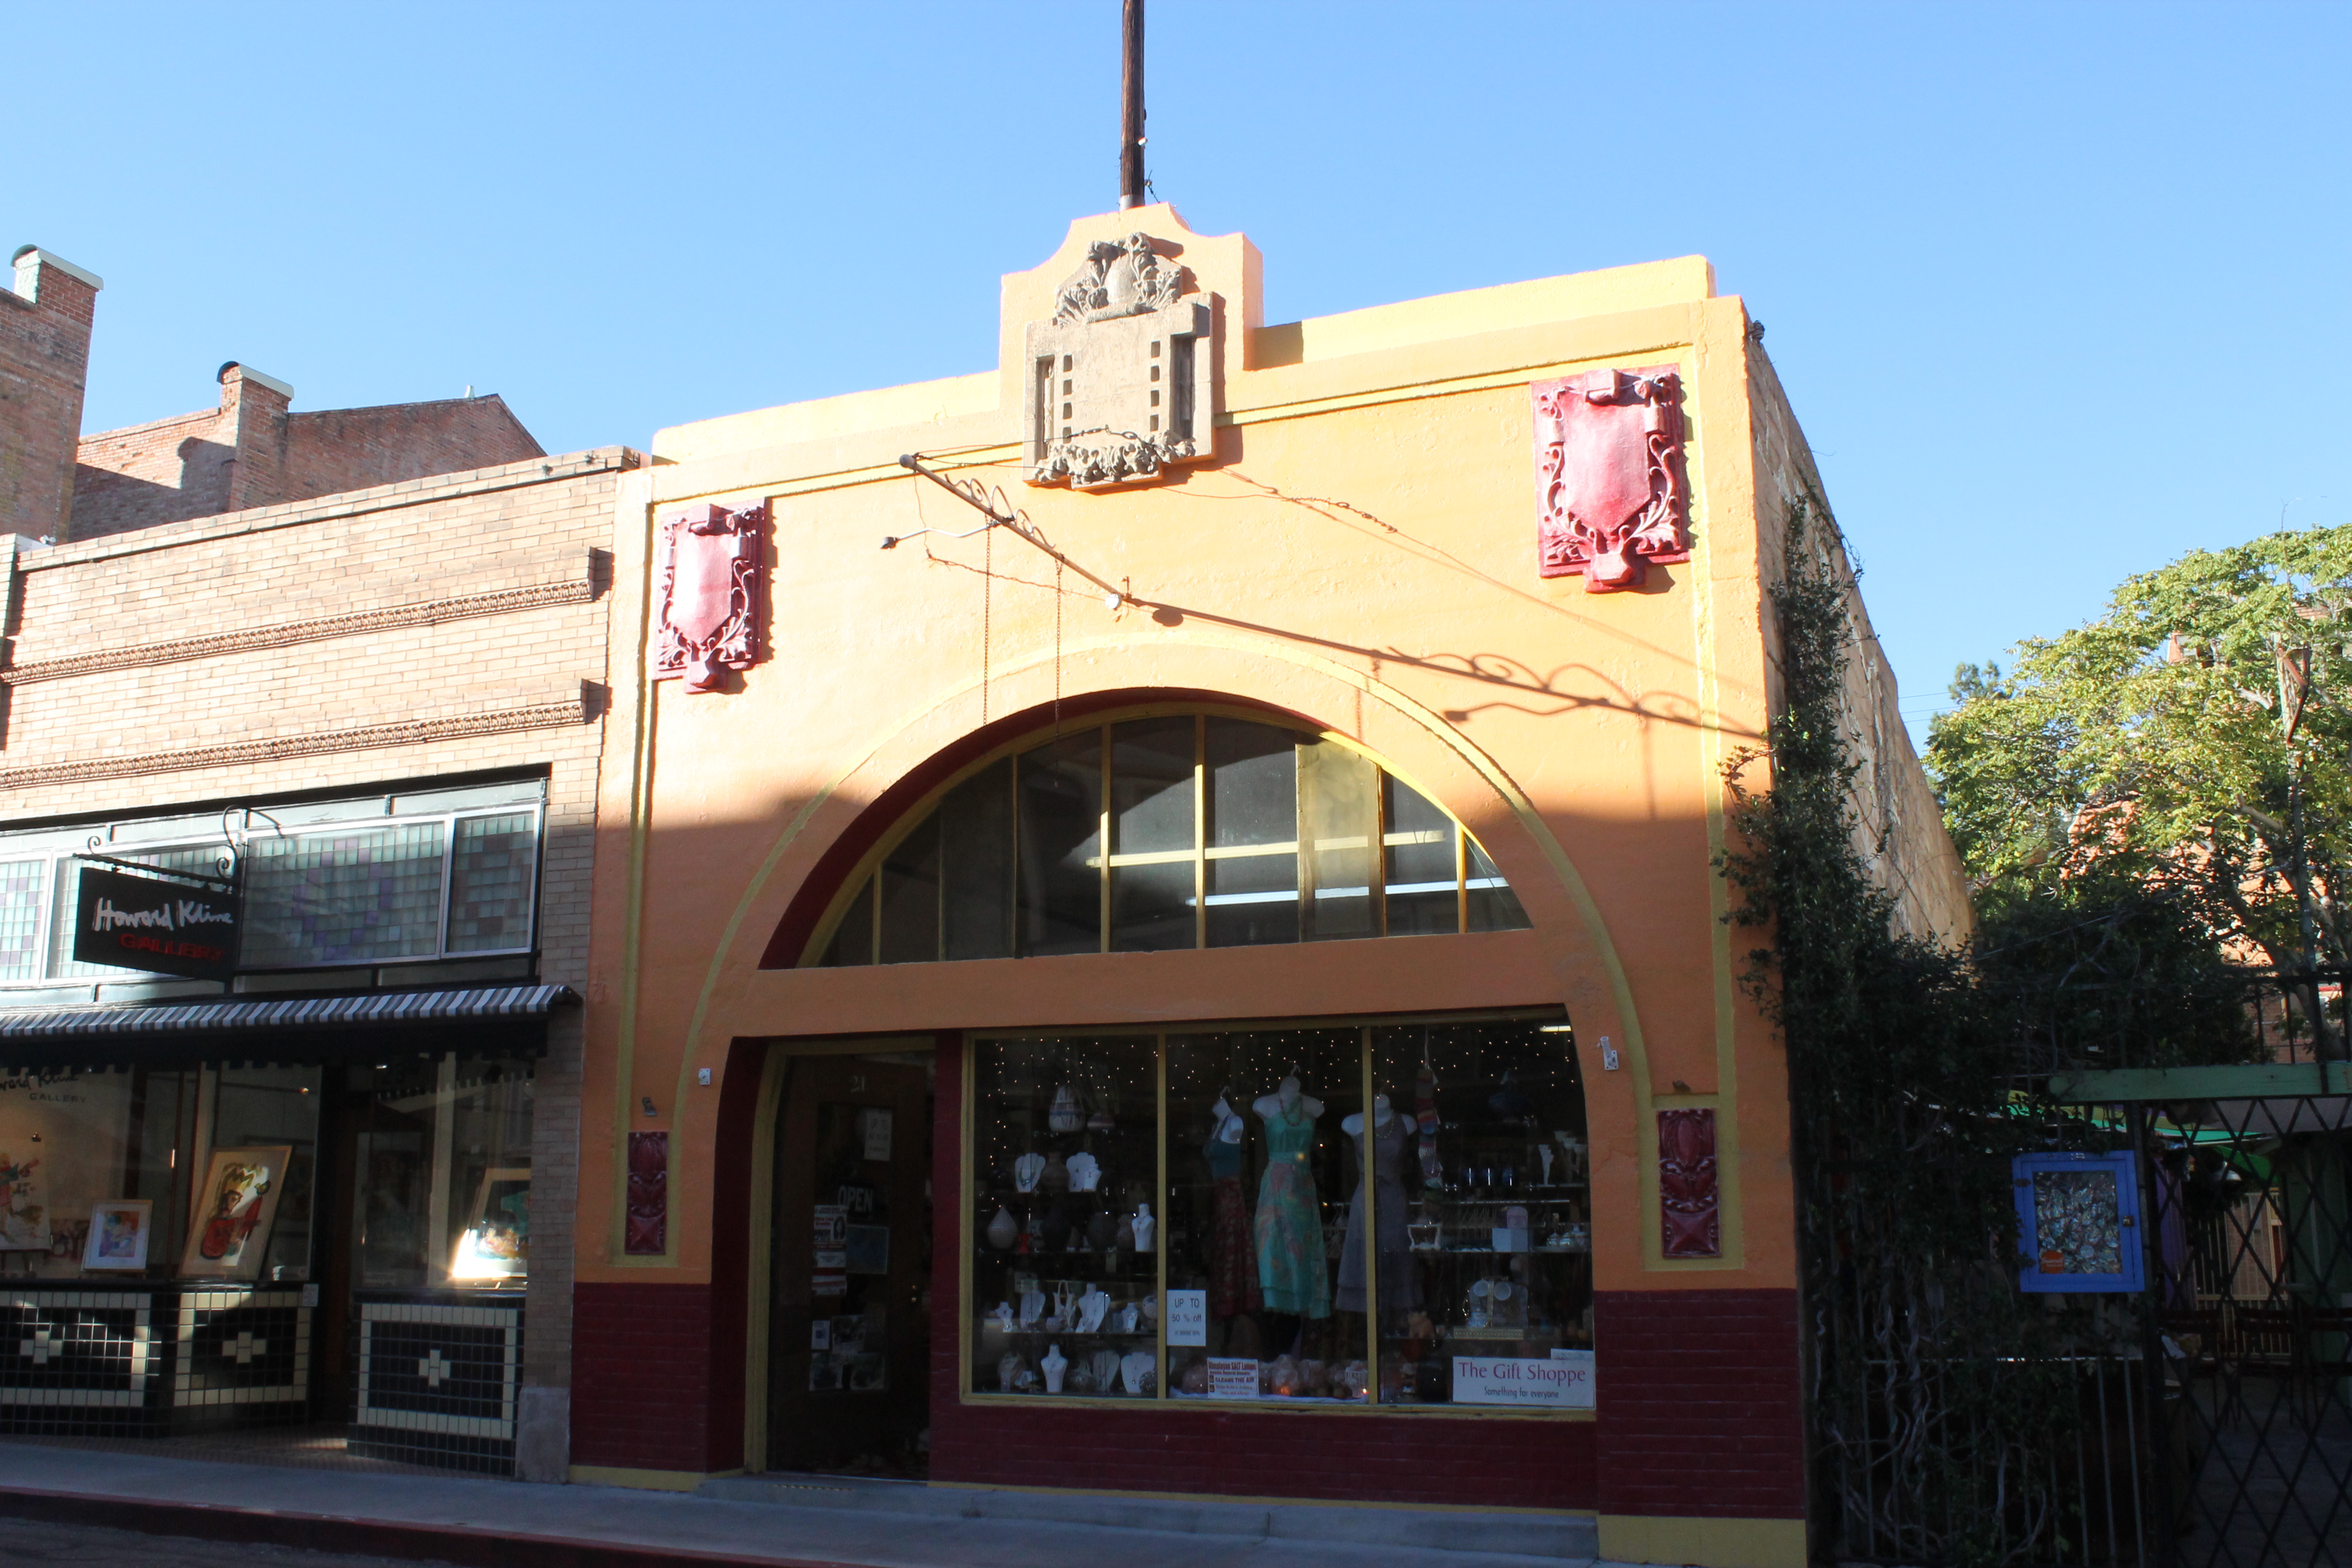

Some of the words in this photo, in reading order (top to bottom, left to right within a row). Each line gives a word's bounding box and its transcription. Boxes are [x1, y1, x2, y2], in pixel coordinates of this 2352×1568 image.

[92, 897, 174, 932] Howard
[119, 933, 225, 961] GALLERY
[0, 1077, 31, 1091] ward
[849, 1075, 866, 1093] 21
[30, 1093, 86, 1102] GALLERY
[837, 1185, 874, 1212] OPEN
[1174, 1298, 1184, 1308] UP
[1190, 1298, 1200, 1308] TO
[1172, 1314, 1180, 1322] 50
[1183, 1314, 1190, 1322] %
[1193, 1314, 1201, 1322] off
[1458, 1362, 1487, 1378] The
[1493, 1363, 1521, 1380] Gift
[1527, 1364, 1586, 1387] Shoppe
[1484, 1386, 1517, 1398] Something
[1520, 1386, 1528, 1397] for
[1531, 1390, 1559, 1400] everyone
